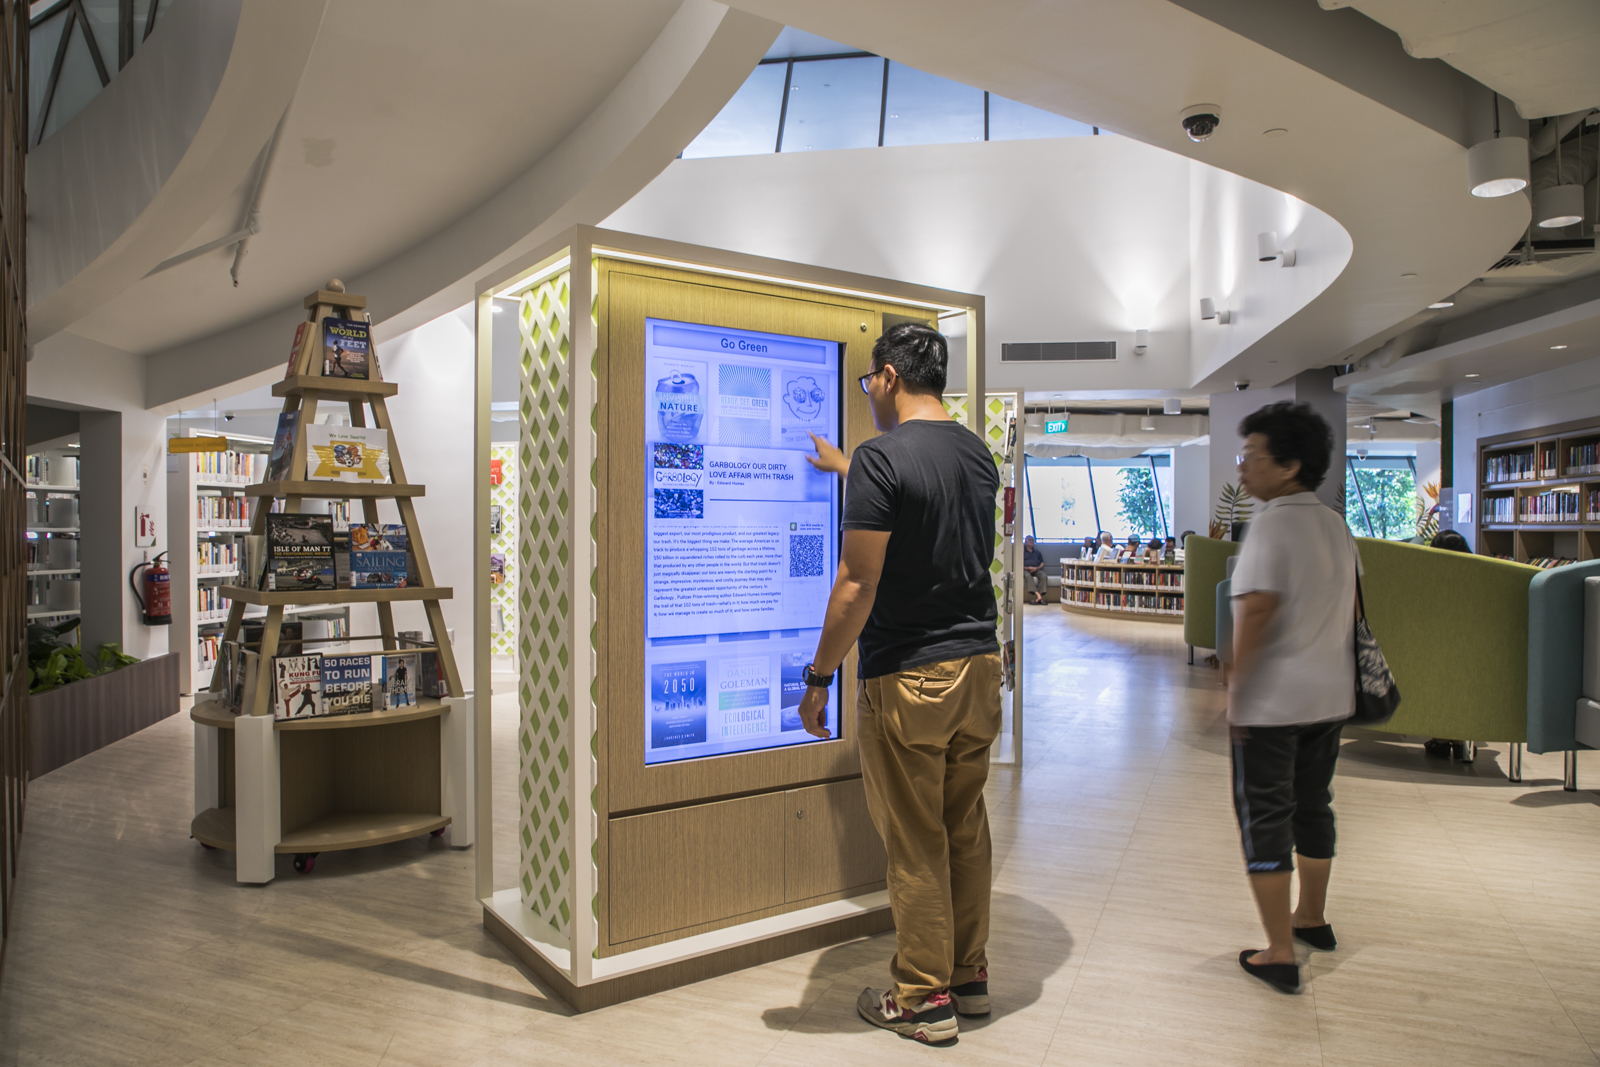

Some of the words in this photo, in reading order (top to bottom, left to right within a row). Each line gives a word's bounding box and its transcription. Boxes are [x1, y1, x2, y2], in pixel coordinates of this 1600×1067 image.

[329, 326, 367, 338] WORLD
[340, 339, 366, 348] FEET
[720, 338, 735, 349] Go
[738, 340, 768, 353] Green
[660, 394, 697, 403] INVISIBLE
[752, 399, 768, 407] GREEN
[660, 402, 698, 412] NATURE
[1048, 423, 1061, 432] EXIT
[709, 461, 750, 469] GARBOLOGY
[356, 557, 404, 567] SAILING
[325, 659, 337, 667] 50
[340, 658, 370, 666] RACES
[325, 670, 340, 680] TO
[344, 668, 370, 679] RUN
[727, 668, 762, 678] DANIEL
[326, 681, 370, 693] BEFORE
[664, 678, 694, 694] 2050
[720, 678, 768, 689] GOLEMAN
[328, 696, 349, 706] YOU
[352, 694, 370, 703] DIE
[725, 710, 765, 724] ECOLOGICAL
[722, 721, 767, 737] INTELLIGENCE
